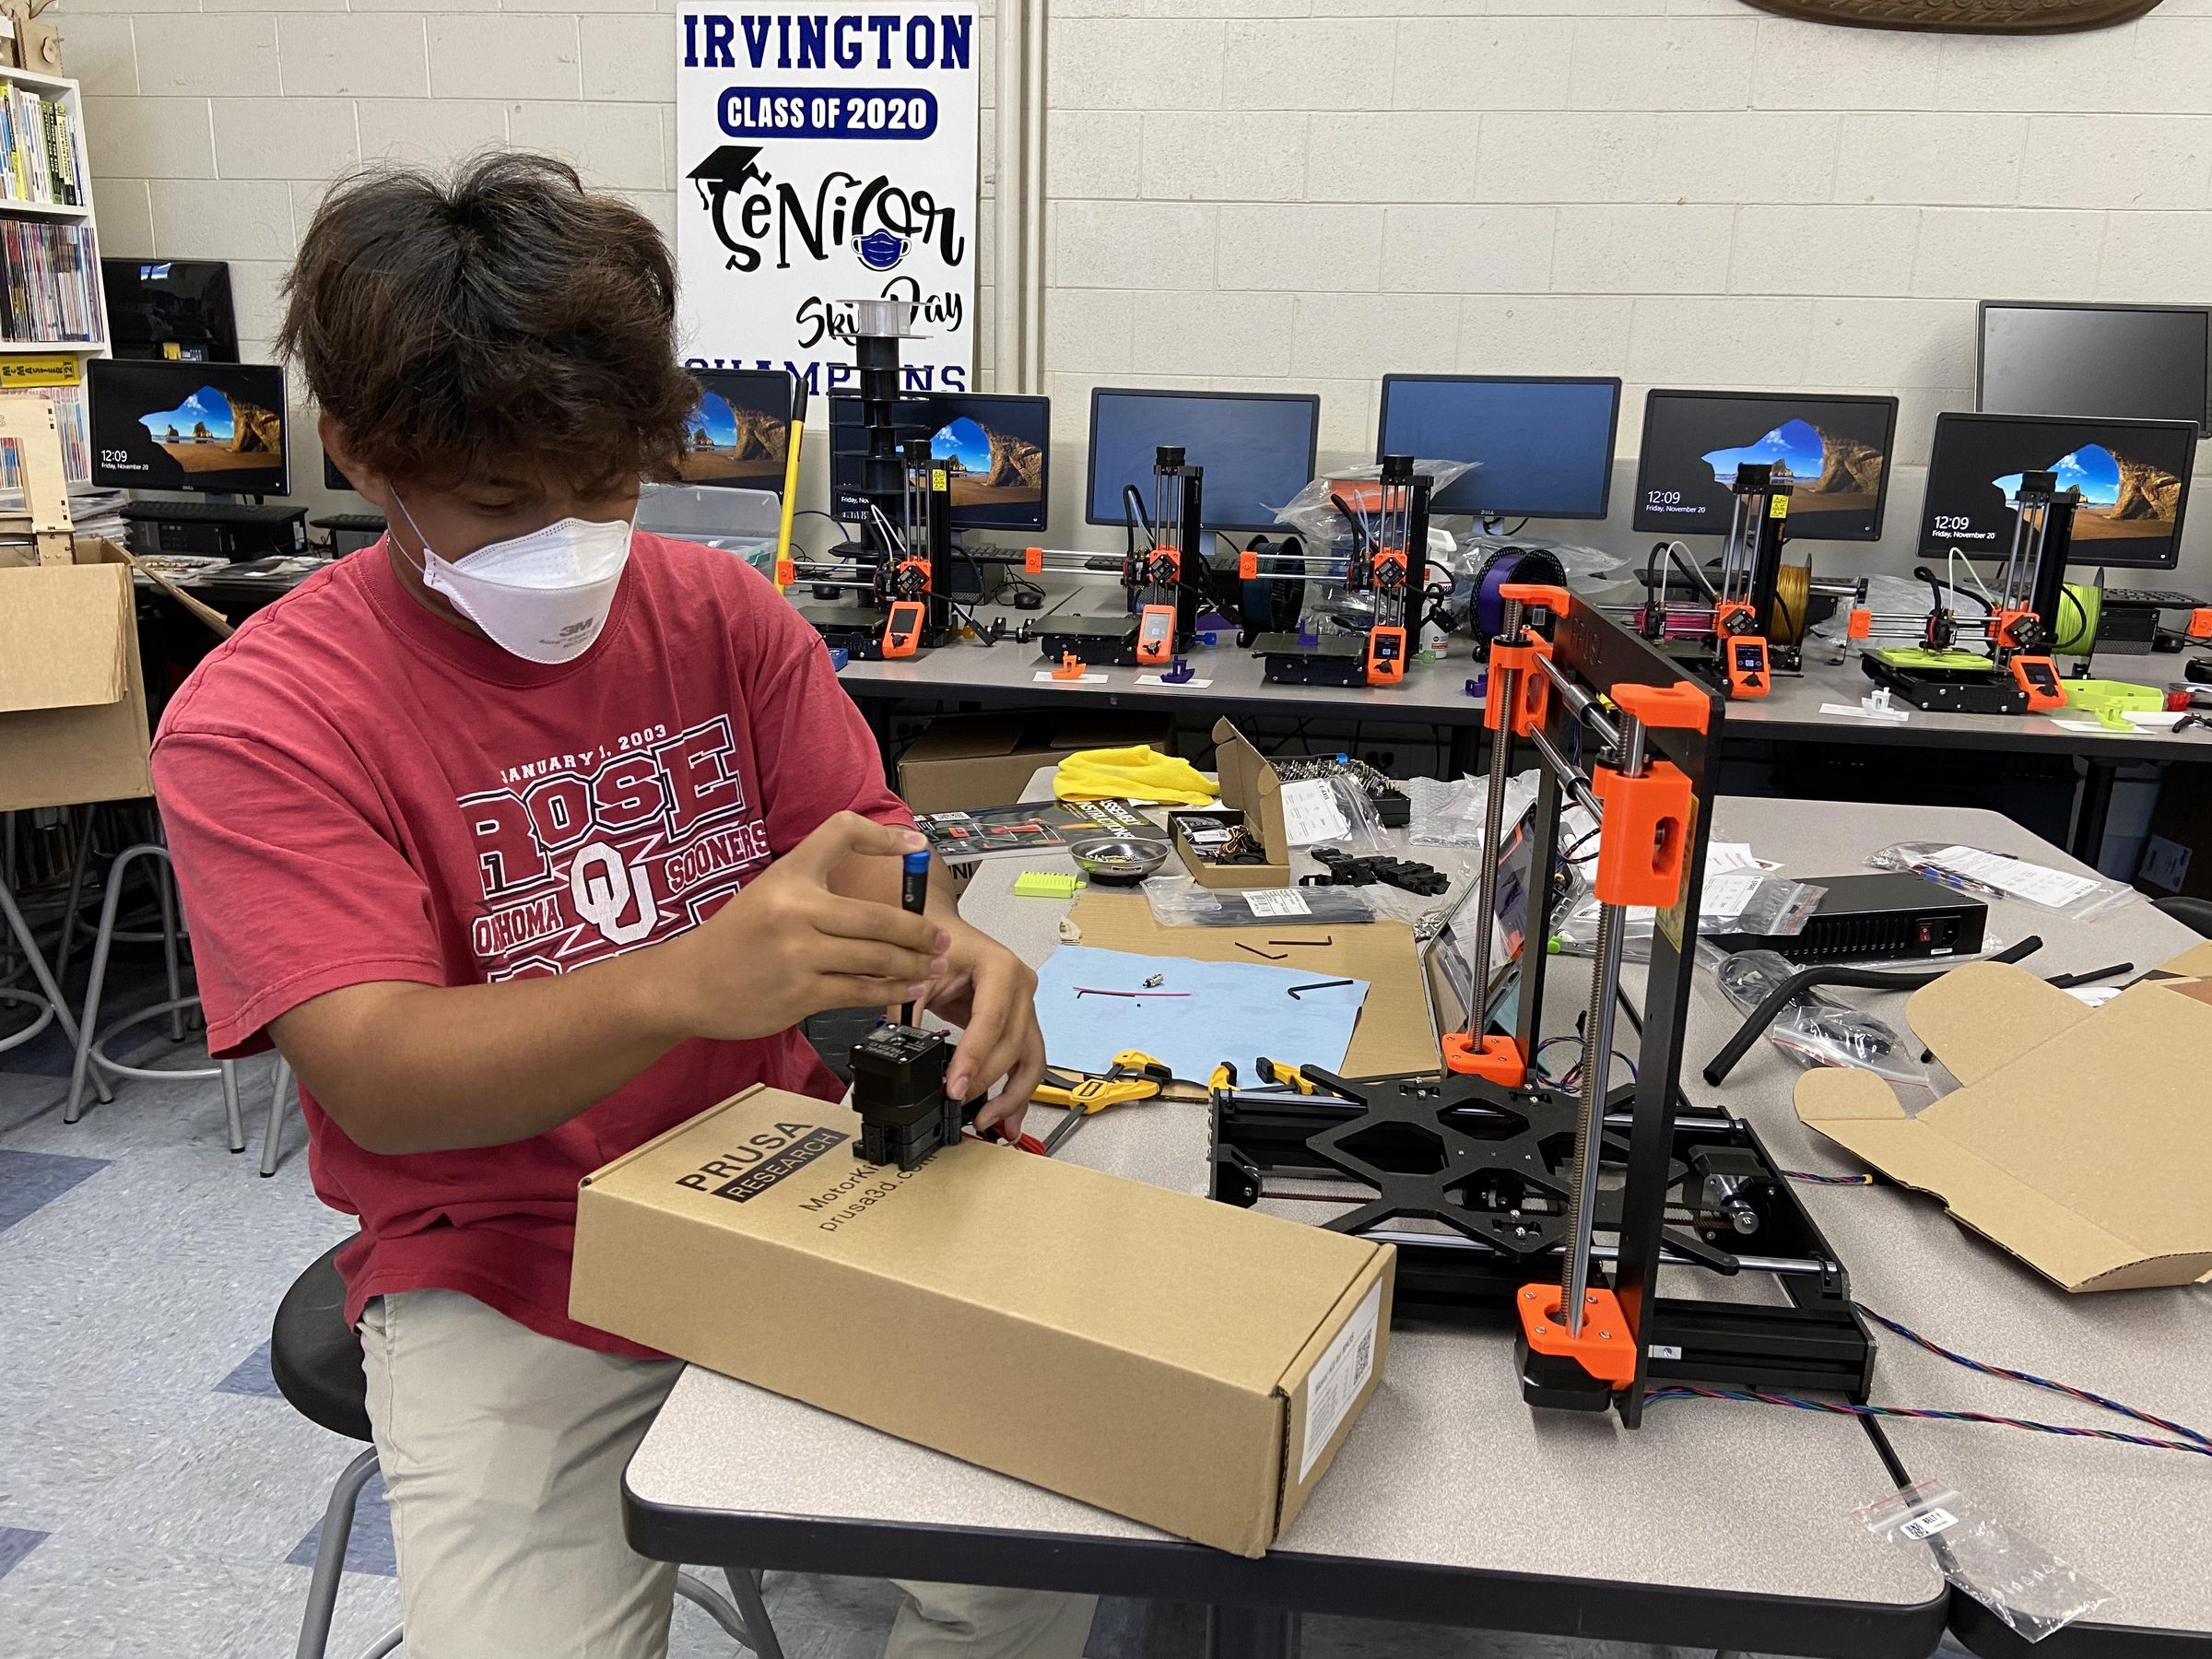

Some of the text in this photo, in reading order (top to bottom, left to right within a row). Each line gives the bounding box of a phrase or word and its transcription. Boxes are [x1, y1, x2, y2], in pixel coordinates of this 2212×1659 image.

[684, 14, 972, 69] IRVINGTON
[726, 96, 927, 130] CLASS OF 2020
[796, 296, 863, 348] Ski
[101, 450, 127, 463] 12:09
[841, 496, 858, 504] Friday,
[1646, 504, 1665, 513] Friday,
[1647, 490, 1681, 504] 12:09
[1932, 530, 1952, 538] Friday,
[1953, 531, 1985, 539] November
[1934, 516, 1970, 530] 12:09
[559, 617, 594, 637] 3M
[618, 724, 666, 750] 2003
[457, 714, 747, 900] ROSE
[665, 819, 771, 894] SOONERS
[570, 841, 660, 947] OU
[675, 1122, 814, 1192] PRUSA
[726, 1133, 840, 1198] RESEARCH
[798, 1164, 880, 1212] MotorKi
